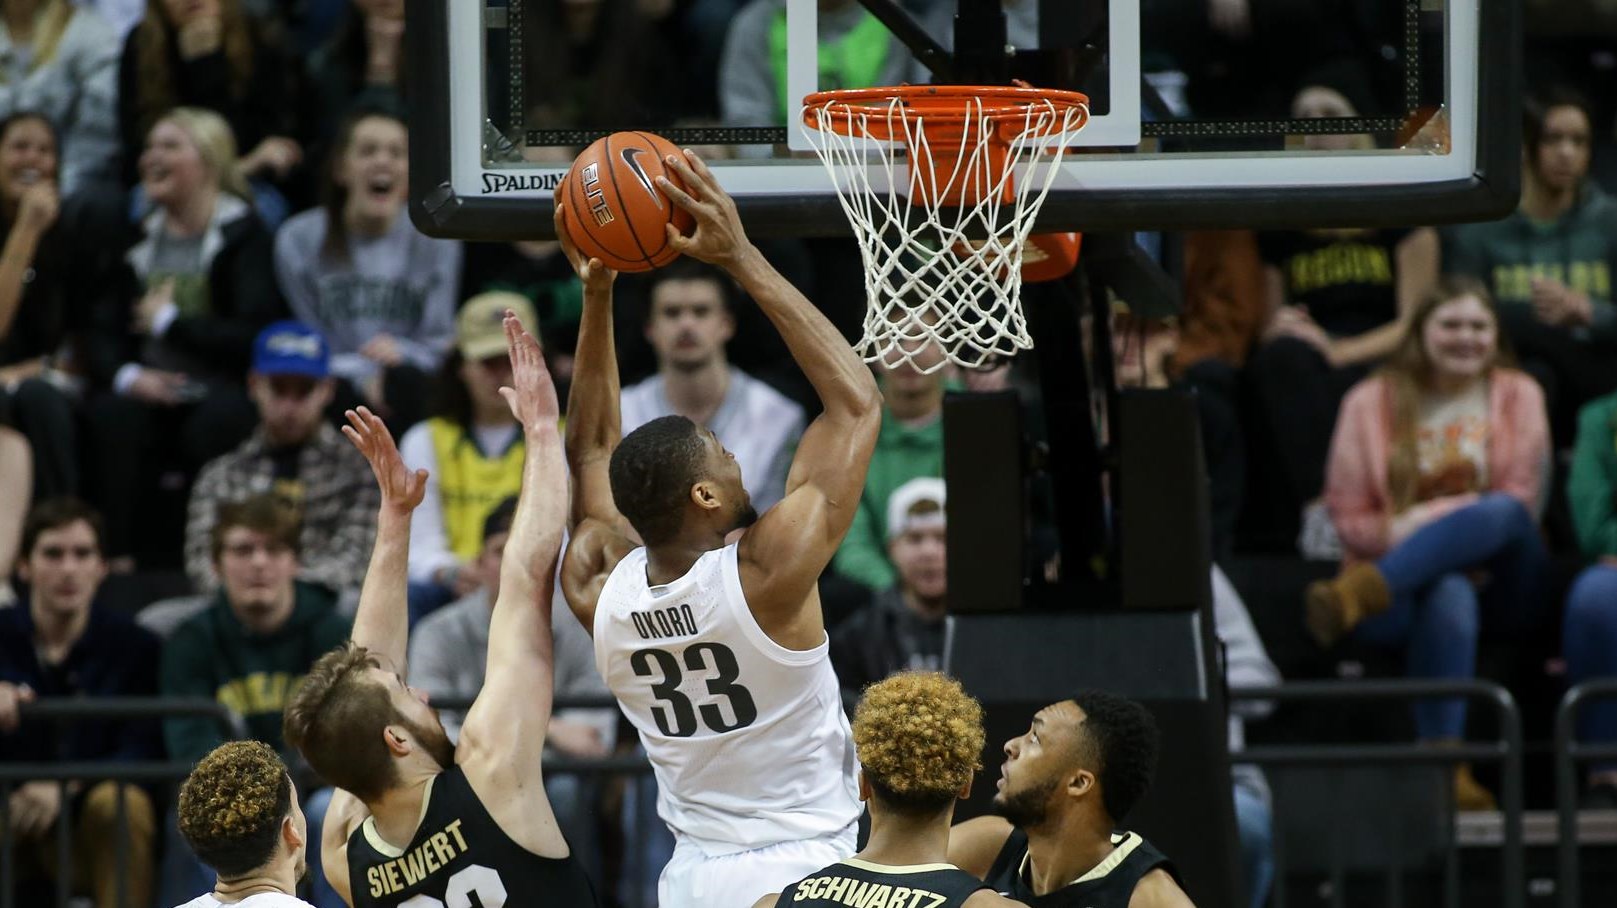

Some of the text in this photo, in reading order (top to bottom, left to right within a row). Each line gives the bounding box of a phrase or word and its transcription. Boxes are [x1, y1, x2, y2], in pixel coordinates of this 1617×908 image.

[482, 172, 563, 194] SPALDIN
[583, 162, 615, 227] ELITE
[631, 604, 698, 639] OKORO
[630, 642, 757, 737] 33
[367, 818, 469, 898] SIEWERT
[793, 876, 948, 908] SCHWARTZ
